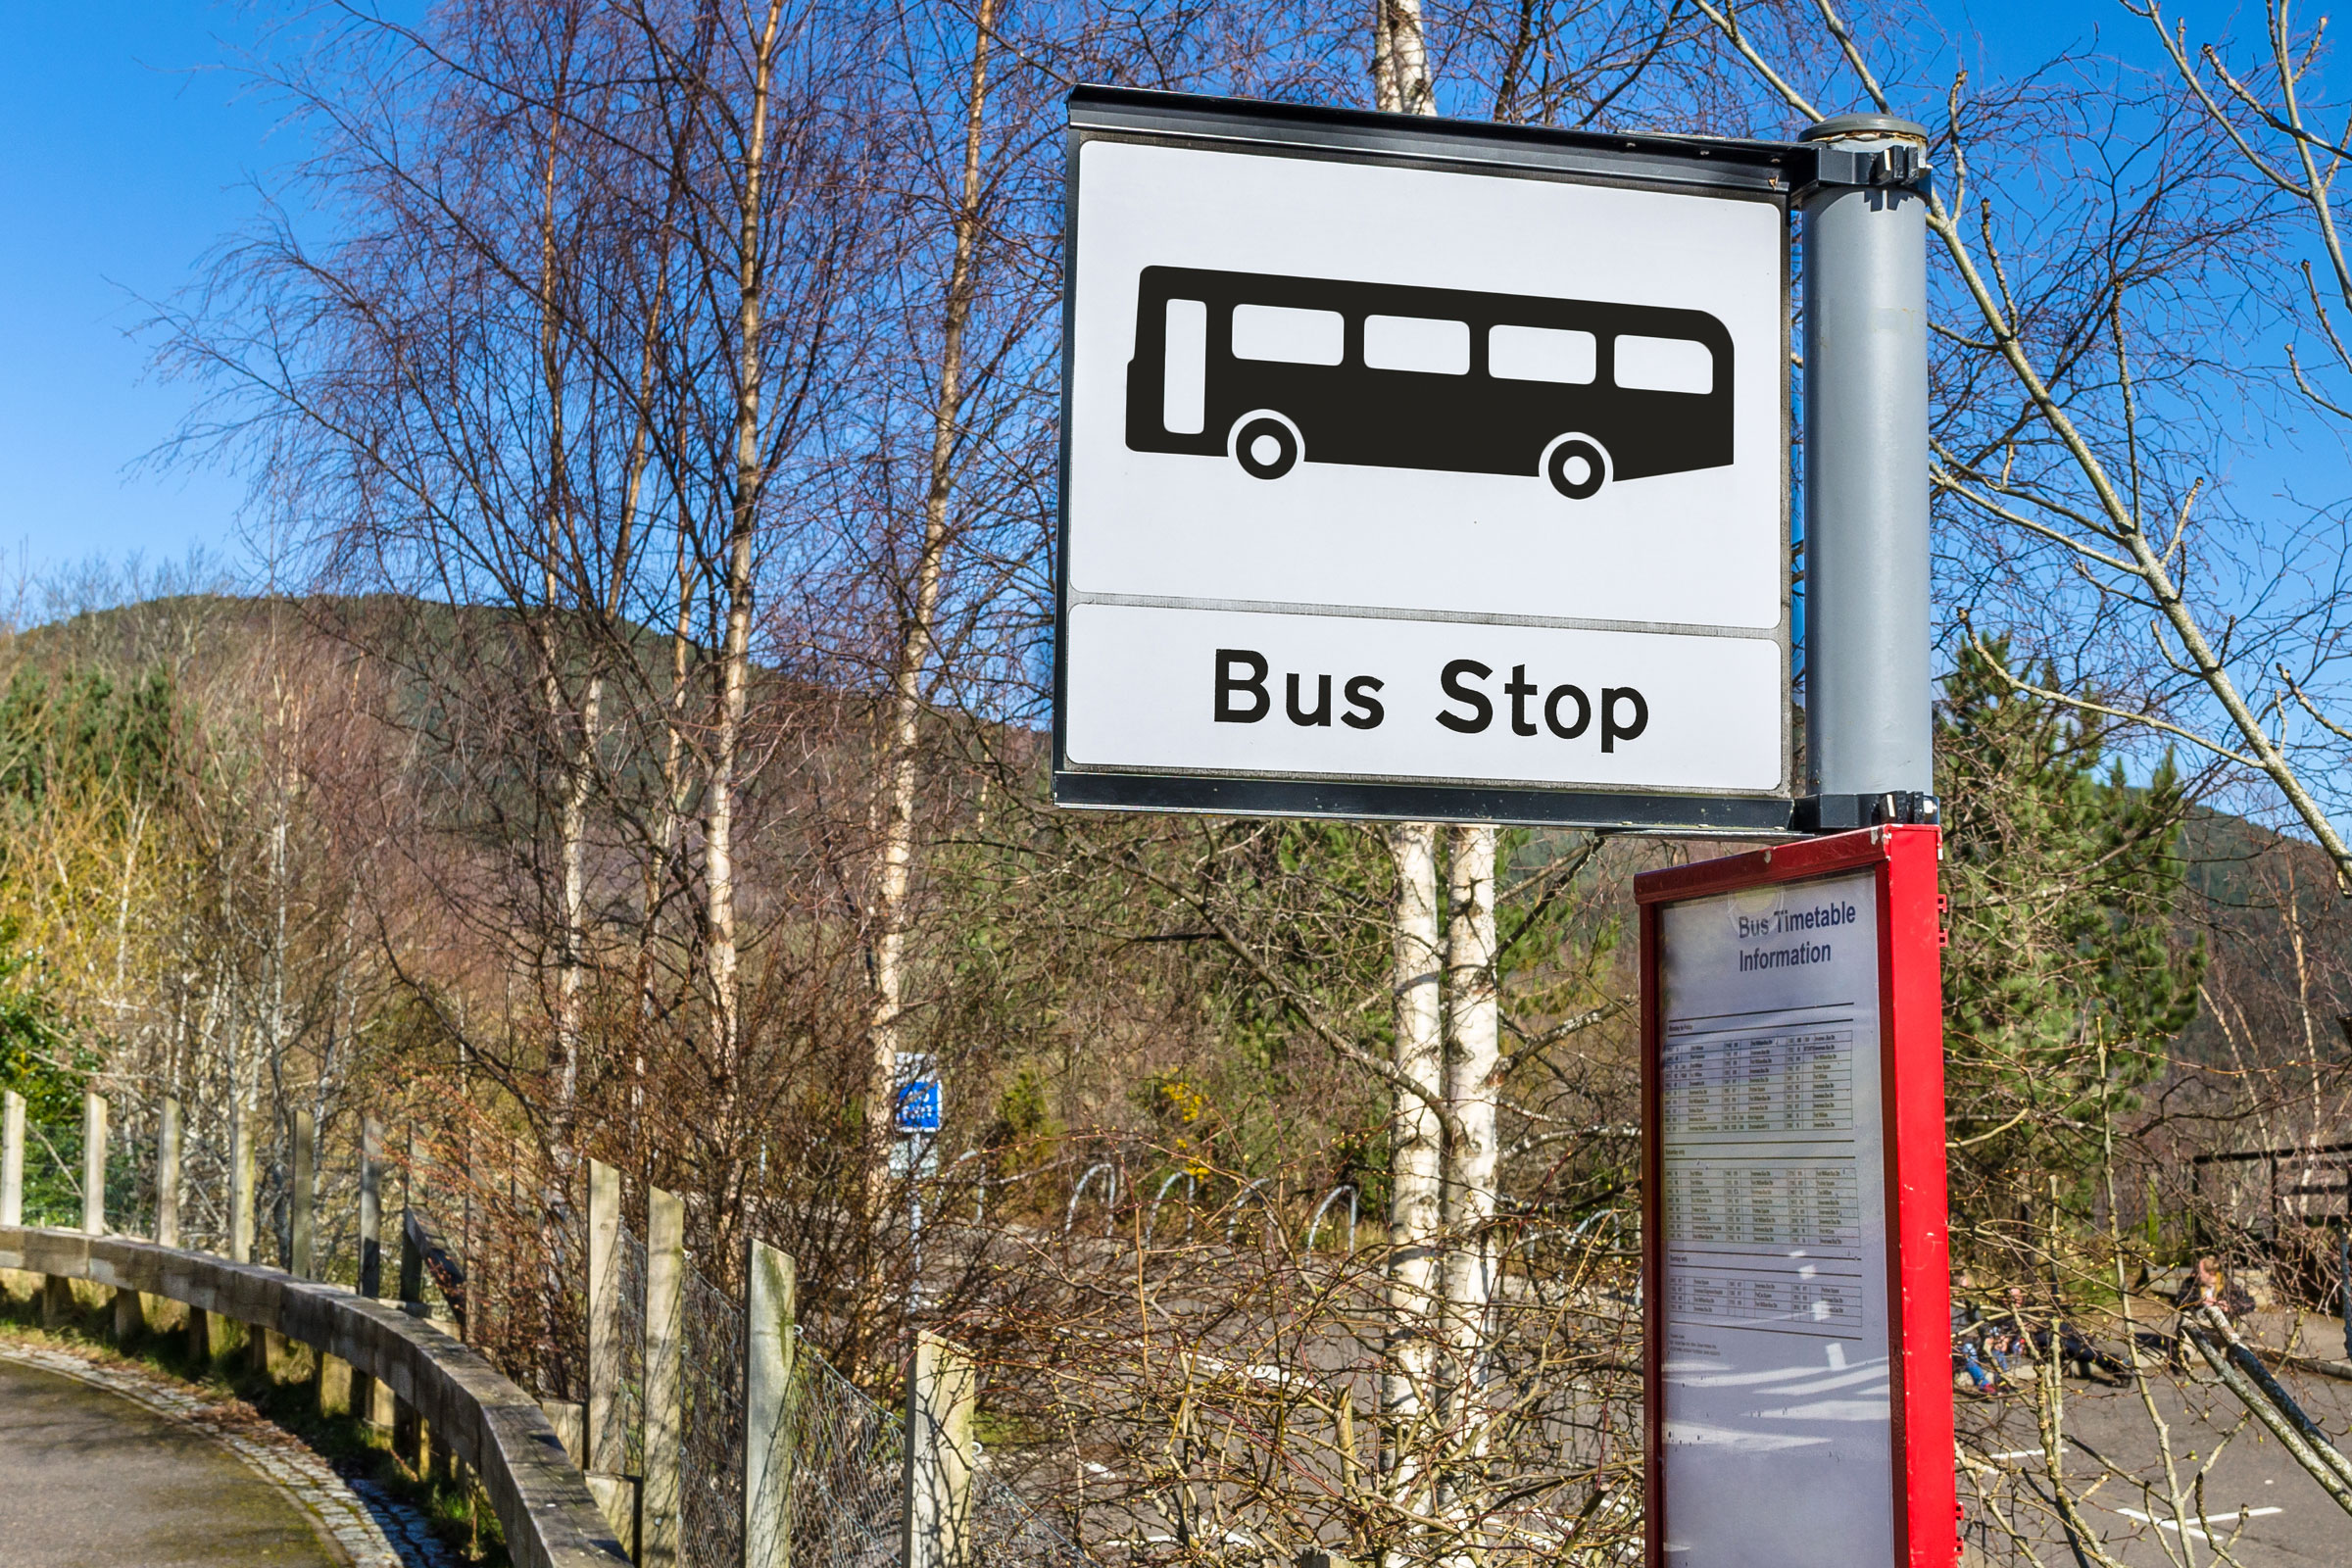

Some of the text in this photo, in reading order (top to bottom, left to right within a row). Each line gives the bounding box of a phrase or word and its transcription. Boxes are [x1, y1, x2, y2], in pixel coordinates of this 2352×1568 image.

[1214, 649, 1648, 754] Bus Stop
[1738, 901, 1856, 939] Bus Timetable
[1739, 941, 1832, 972] Information
